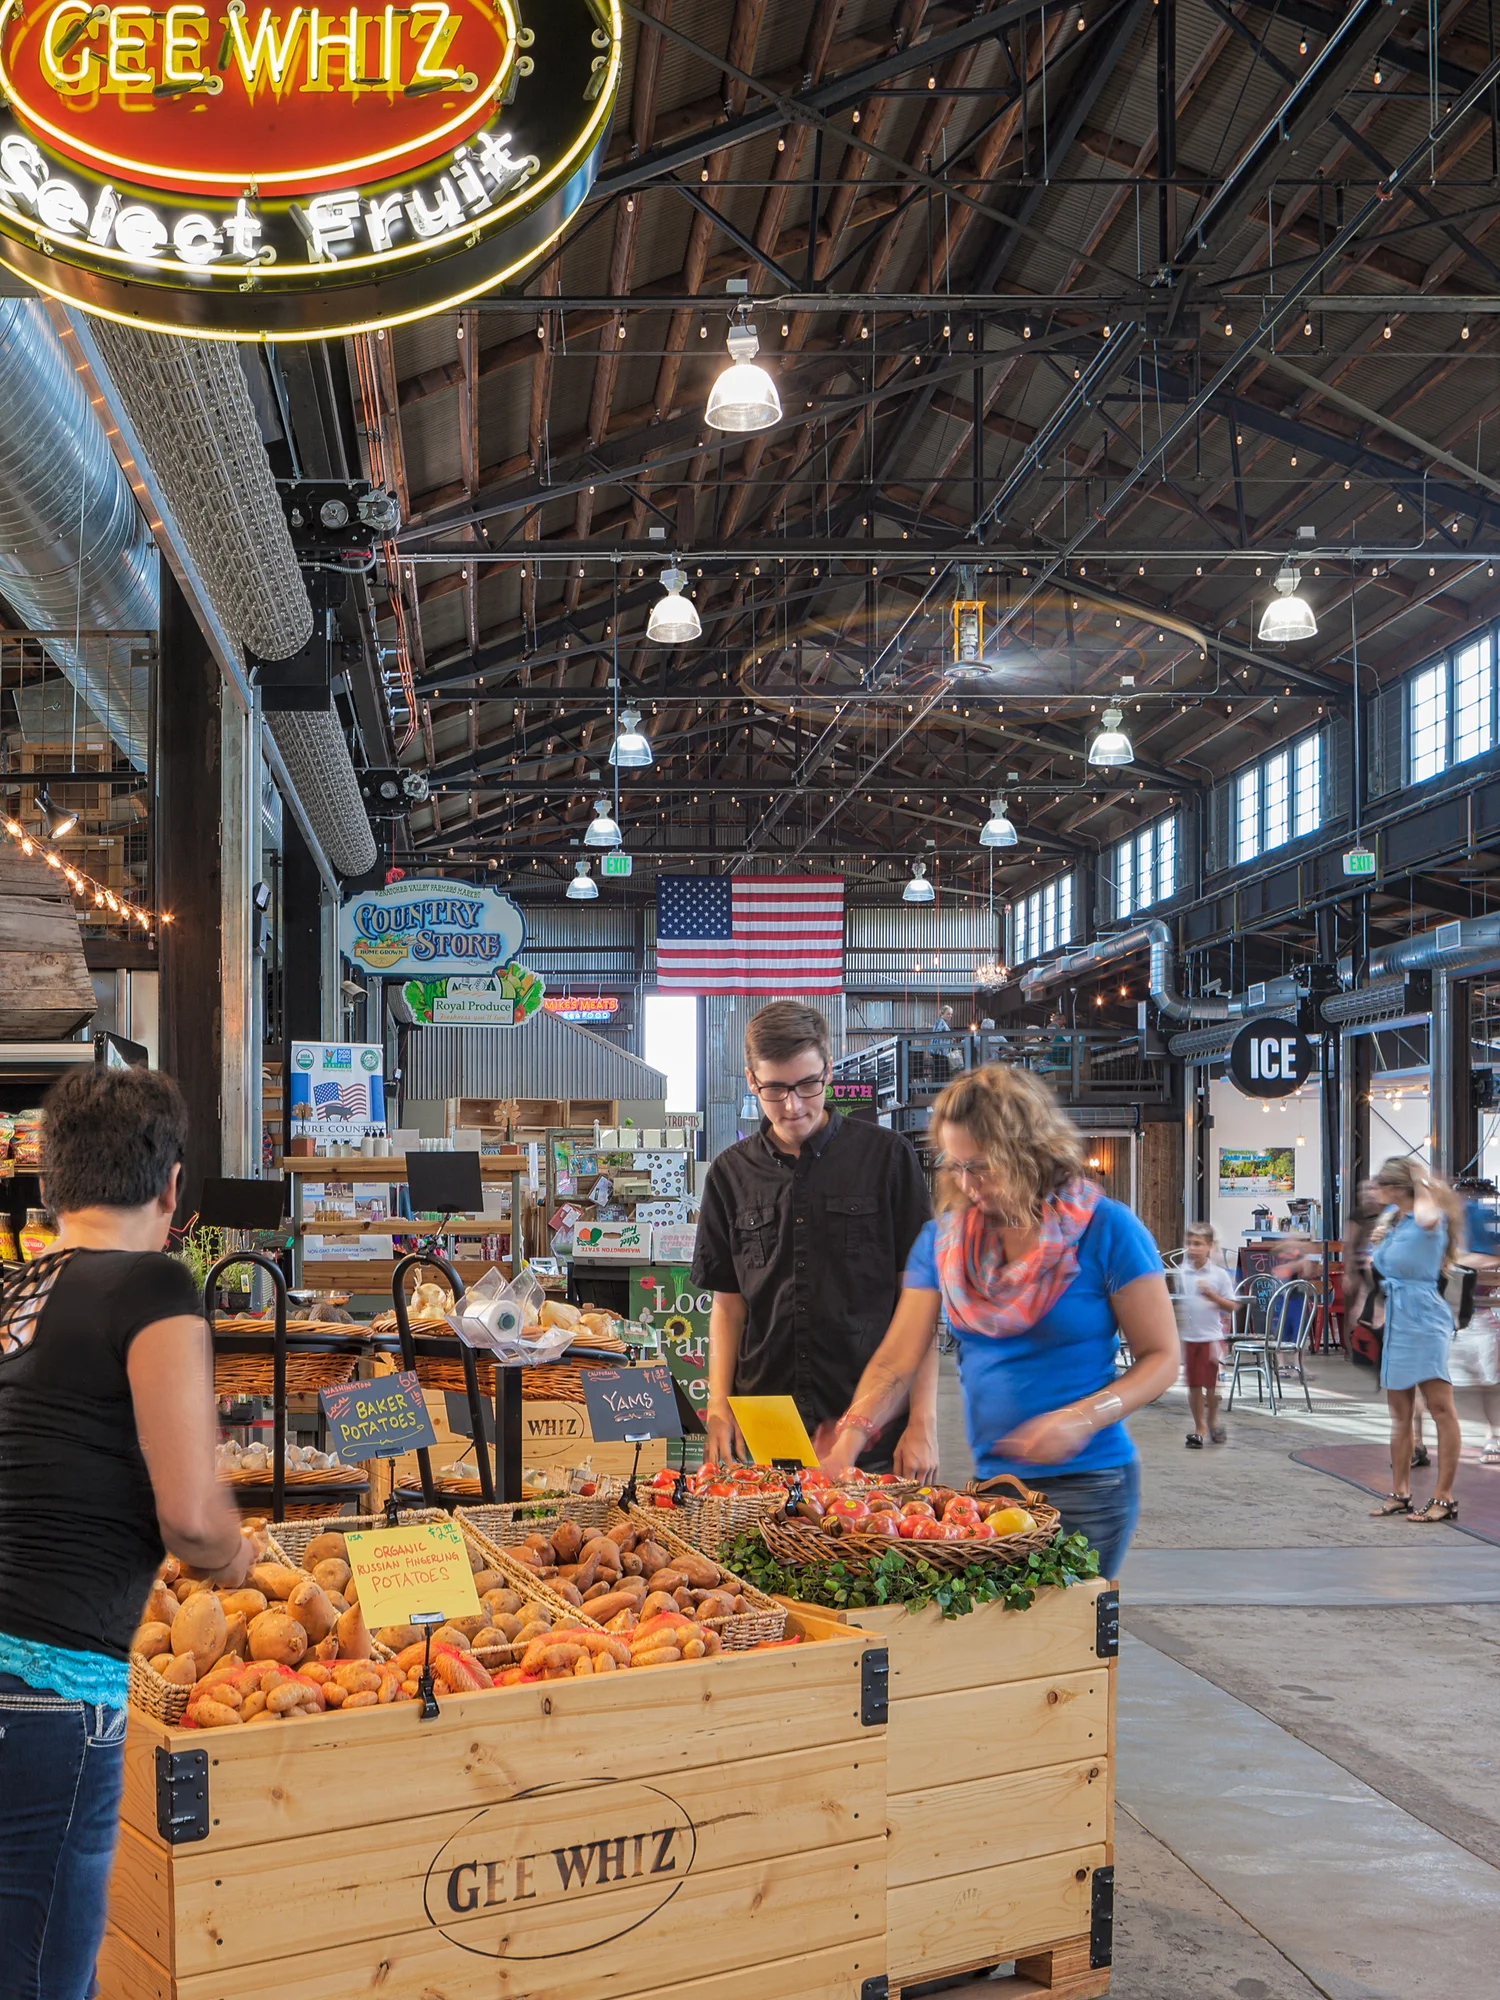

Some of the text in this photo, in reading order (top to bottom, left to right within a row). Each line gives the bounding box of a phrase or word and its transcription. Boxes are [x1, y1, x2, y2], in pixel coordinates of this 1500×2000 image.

[40, 2, 467, 95] GEE WHIZ
[0, 131, 529, 265] Select Fruit
[606, 857, 629, 874] EXIT
[1349, 855, 1372, 873] EXIT
[408, 883, 430, 892] VALLEY
[430, 884, 457, 894] FARMERS
[457, 887, 481, 899] MARKET
[354, 899, 484, 940] COUNTRY
[413, 930, 501, 961] STORE
[435, 1000, 511, 1013] Royal Produce
[544, 999, 617, 1011] MIKE'S MEATS
[1250, 1037, 1297, 1080] ICE
[825, 1085, 873, 1098] OUTH
[296, 1125, 384, 1134] PURE COUNTRY
[619, 1234, 641, 1248] Select
[621, 1225, 637, 1238] Fruit
[653, 1285, 714, 1315] Loc
[653, 1328, 716, 1357] Far
[323, 1381, 371, 1395] WASHINGTON
[326, 1396, 350, 1419] LOCAL
[355, 1393, 408, 1420] BAKER
[602, 1390, 654, 1412] YAMS
[340, 1411, 417, 1443] POTATOES
[527, 1418, 577, 1437] WHIZ
[685, 1433, 705, 1442] able
[347, 1532, 363, 1542] USA
[373, 1542, 427, 1559] ORGANIC
[356, 1551, 459, 1577] RUSSIAN FINGERLING
[371, 1566, 450, 1594] POTATOES
[447, 1826, 677, 1914] GEE WHIZ
